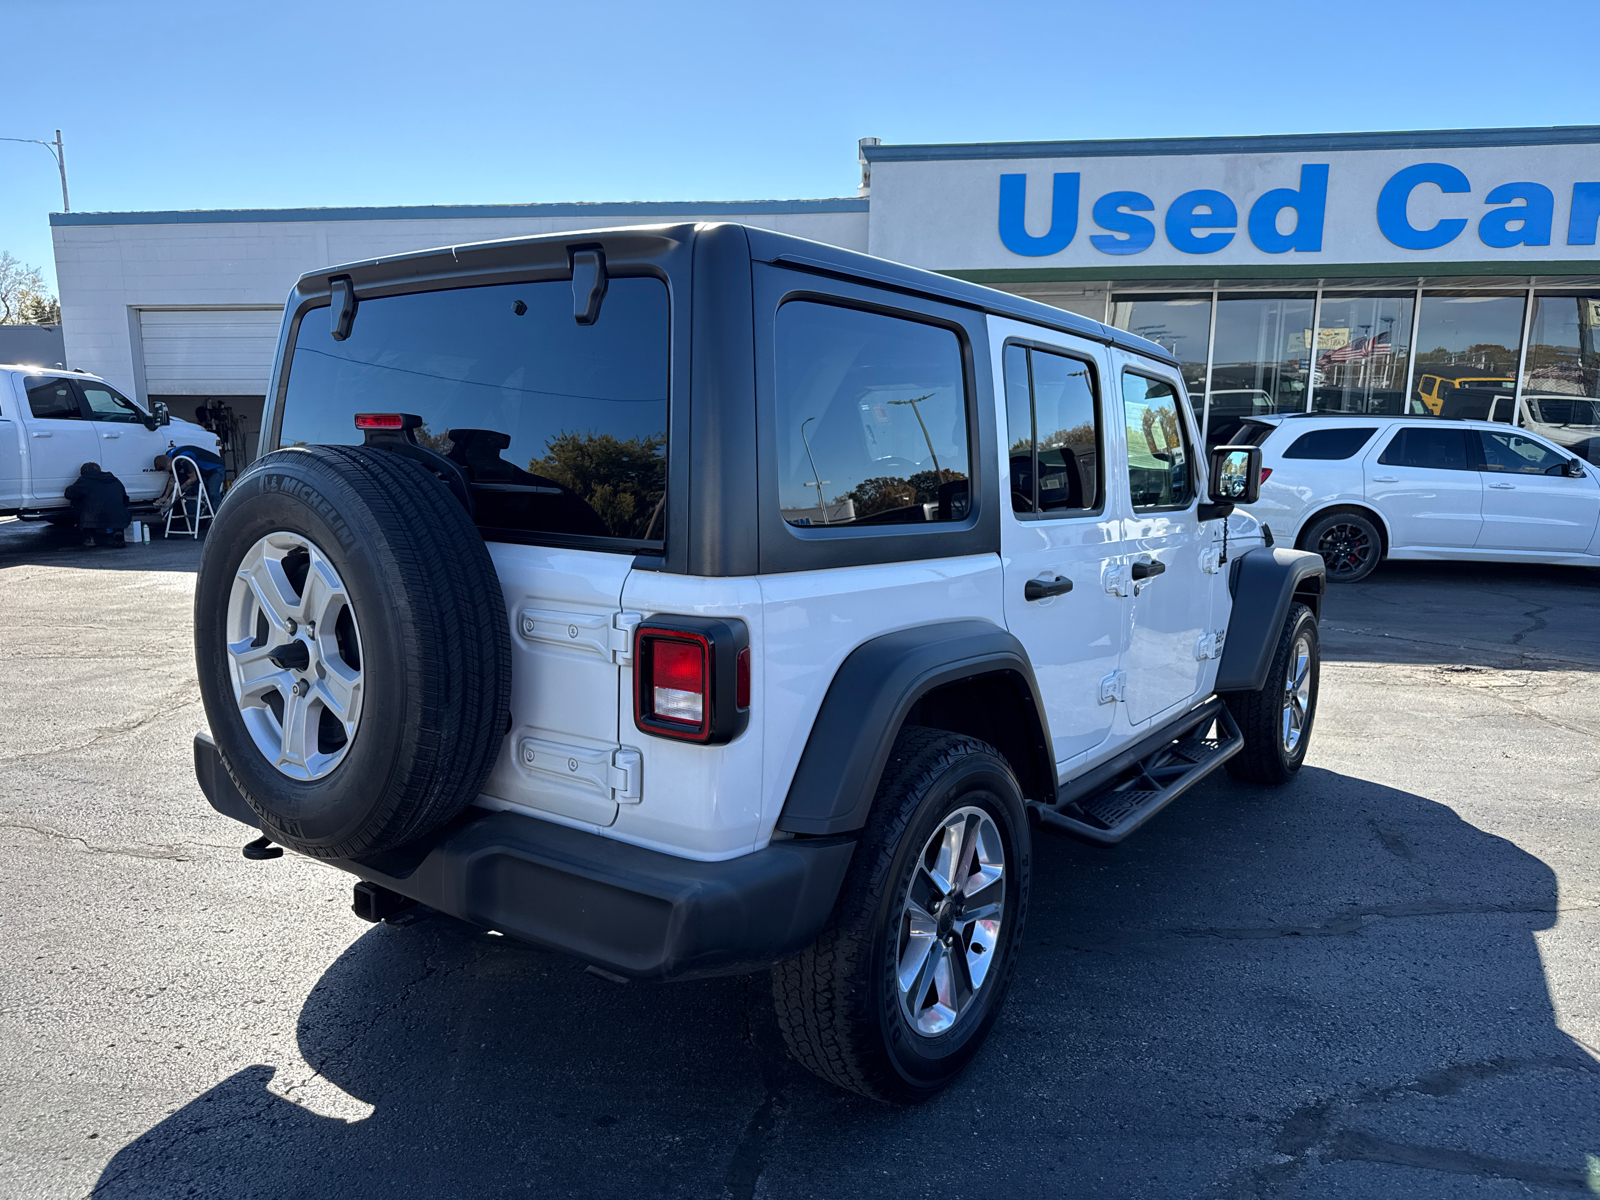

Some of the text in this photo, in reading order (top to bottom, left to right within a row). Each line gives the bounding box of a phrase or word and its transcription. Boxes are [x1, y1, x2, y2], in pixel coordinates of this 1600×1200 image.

[998, 163, 1330, 257] Used
[280, 476, 355, 546] MICHELIN
[221, 756, 281, 828] MICHELIN
